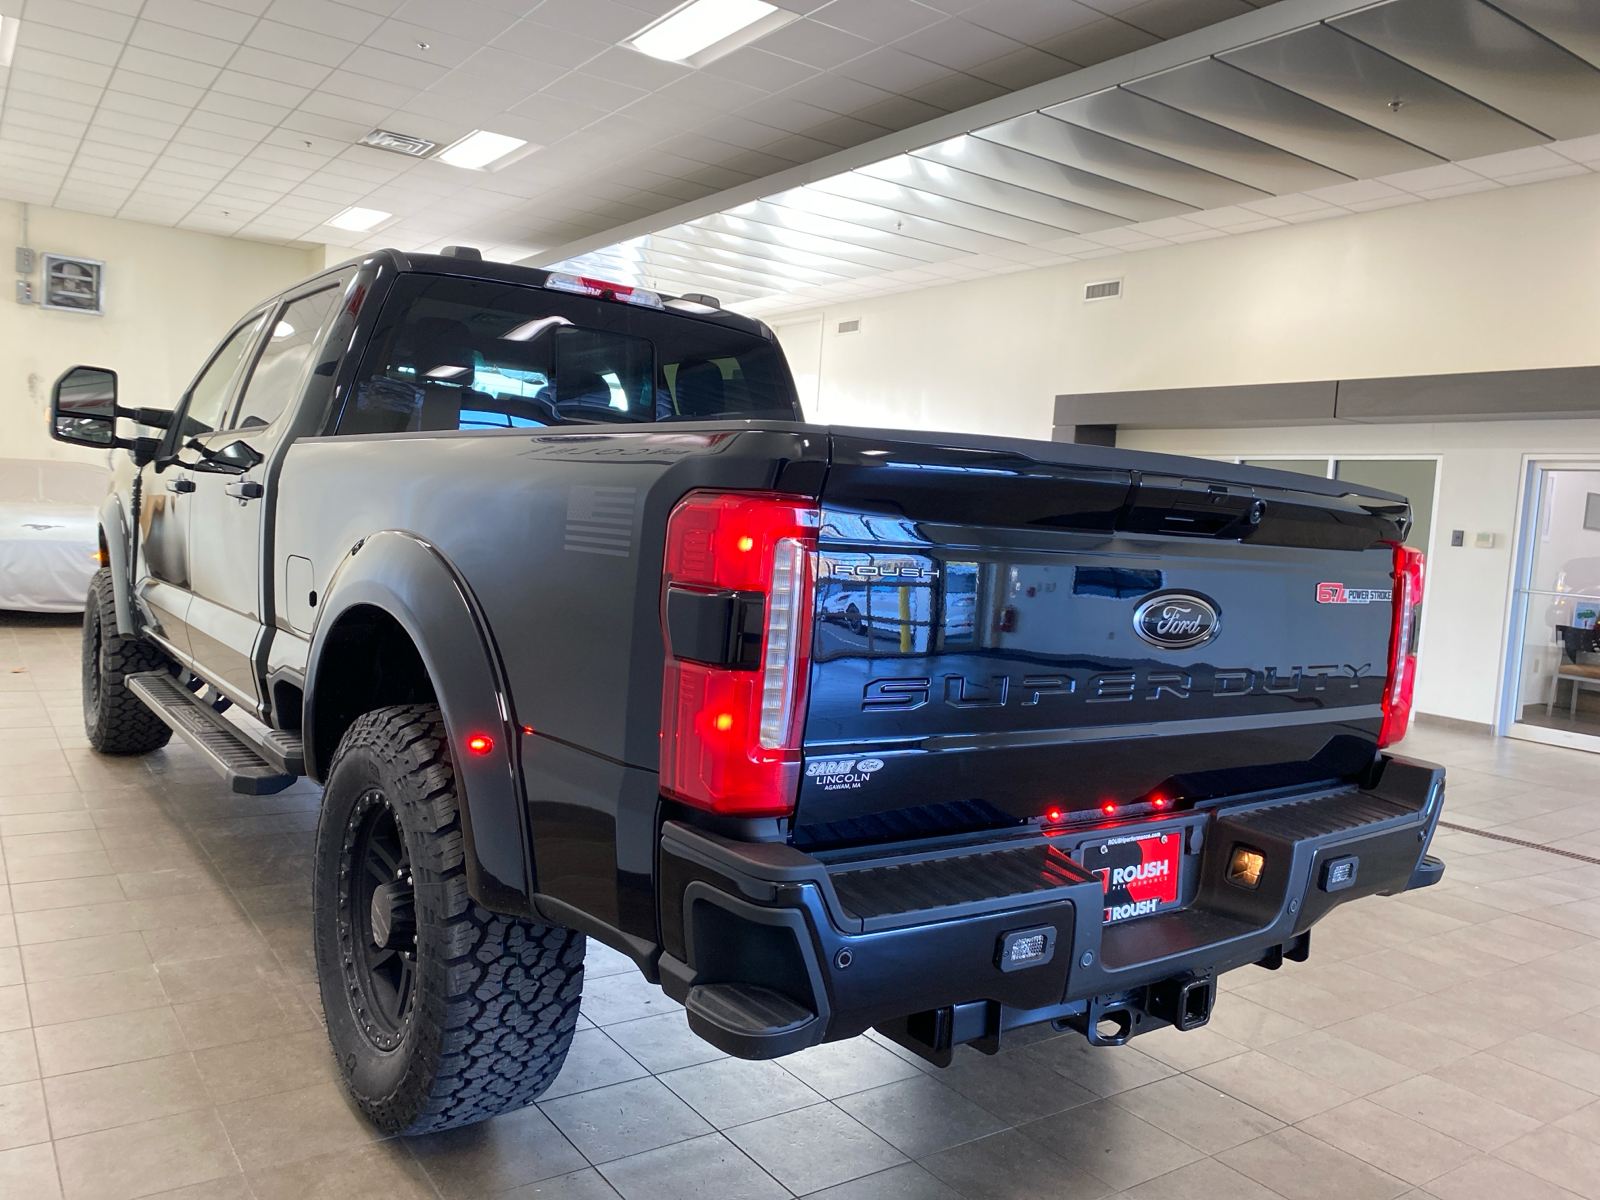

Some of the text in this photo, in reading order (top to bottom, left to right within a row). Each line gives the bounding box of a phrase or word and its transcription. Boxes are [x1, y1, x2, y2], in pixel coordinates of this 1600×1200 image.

[834, 565, 940, 579] ROUSH
[1348, 590, 1369, 600] POWER
[1370, 591, 1391, 600] STROKE
[1157, 606, 1202, 635] Ford
[861, 663, 1372, 712] SUPER DUTY
[806, 760, 856, 776] SARAT
[816, 773, 870, 785] LINCOLN
[824, 783, 851, 791] AGAWAM,
[1113, 859, 1169, 885] ROUSH
[1112, 876, 1168, 890] PERFORMANCE
[1112, 899, 1157, 921] ROUSH
